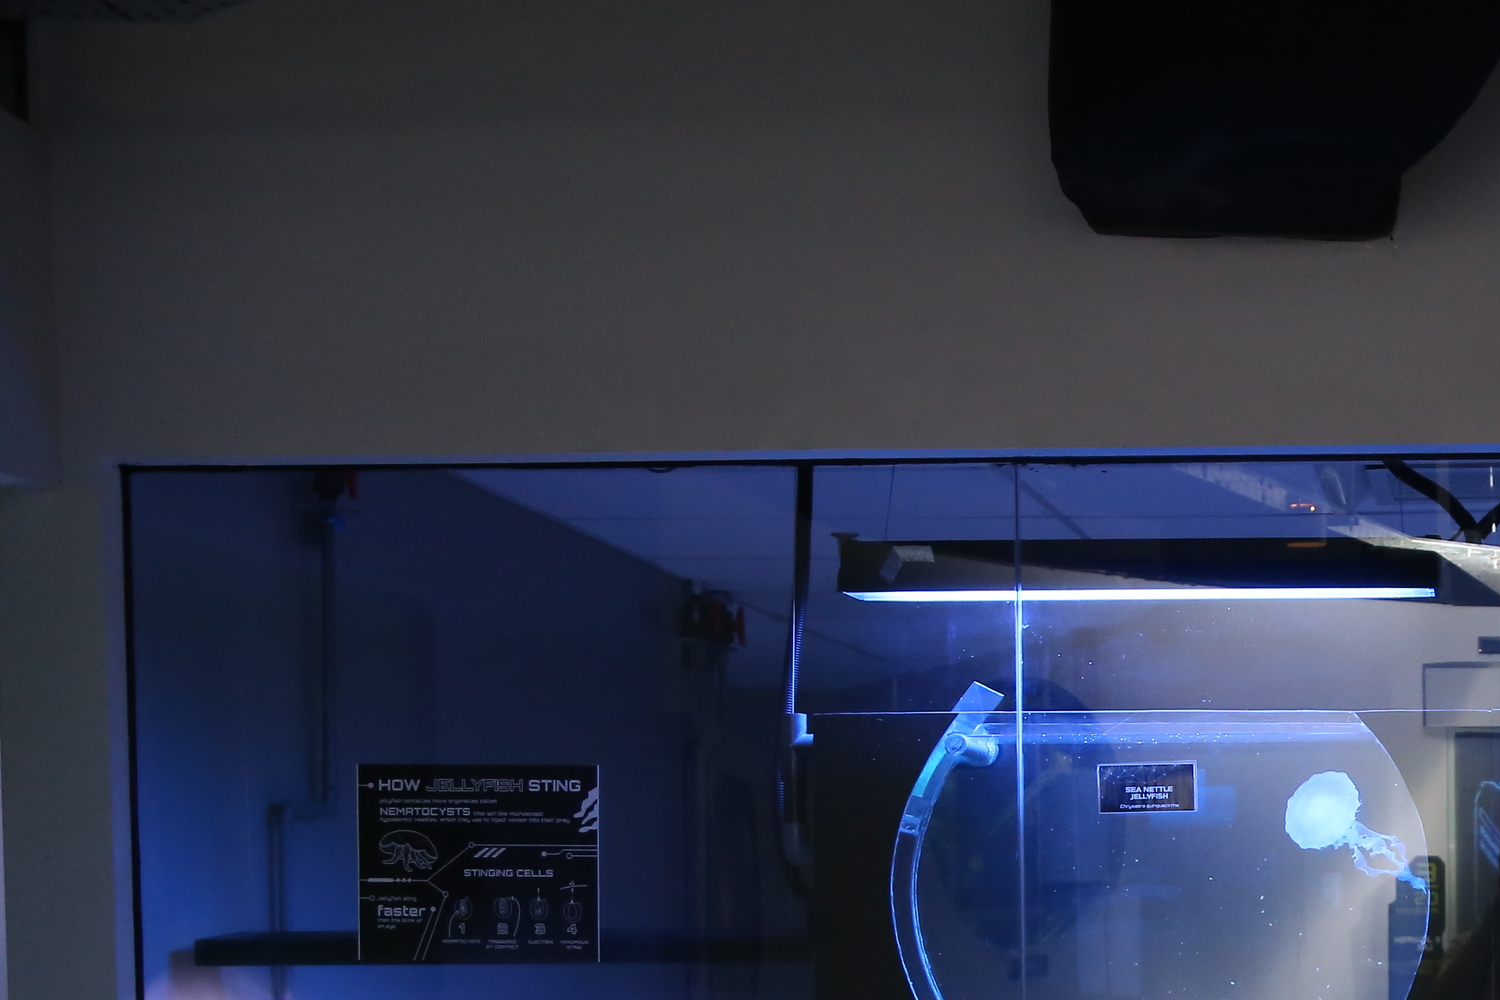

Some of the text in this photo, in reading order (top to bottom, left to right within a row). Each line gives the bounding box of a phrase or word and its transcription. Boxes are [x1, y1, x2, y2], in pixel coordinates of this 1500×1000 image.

[379, 779, 580, 792] HOW JELLYFISH STING
[380, 807, 471, 816] NEMATOCYSTS
[464, 869, 553, 877] STINGING CELLS
[378, 905, 426, 916] faster
[458, 922, 466, 934] 1
[497, 922, 509, 934] 2
[534, 923, 546, 935] 3
[566, 923, 578, 935] 4
